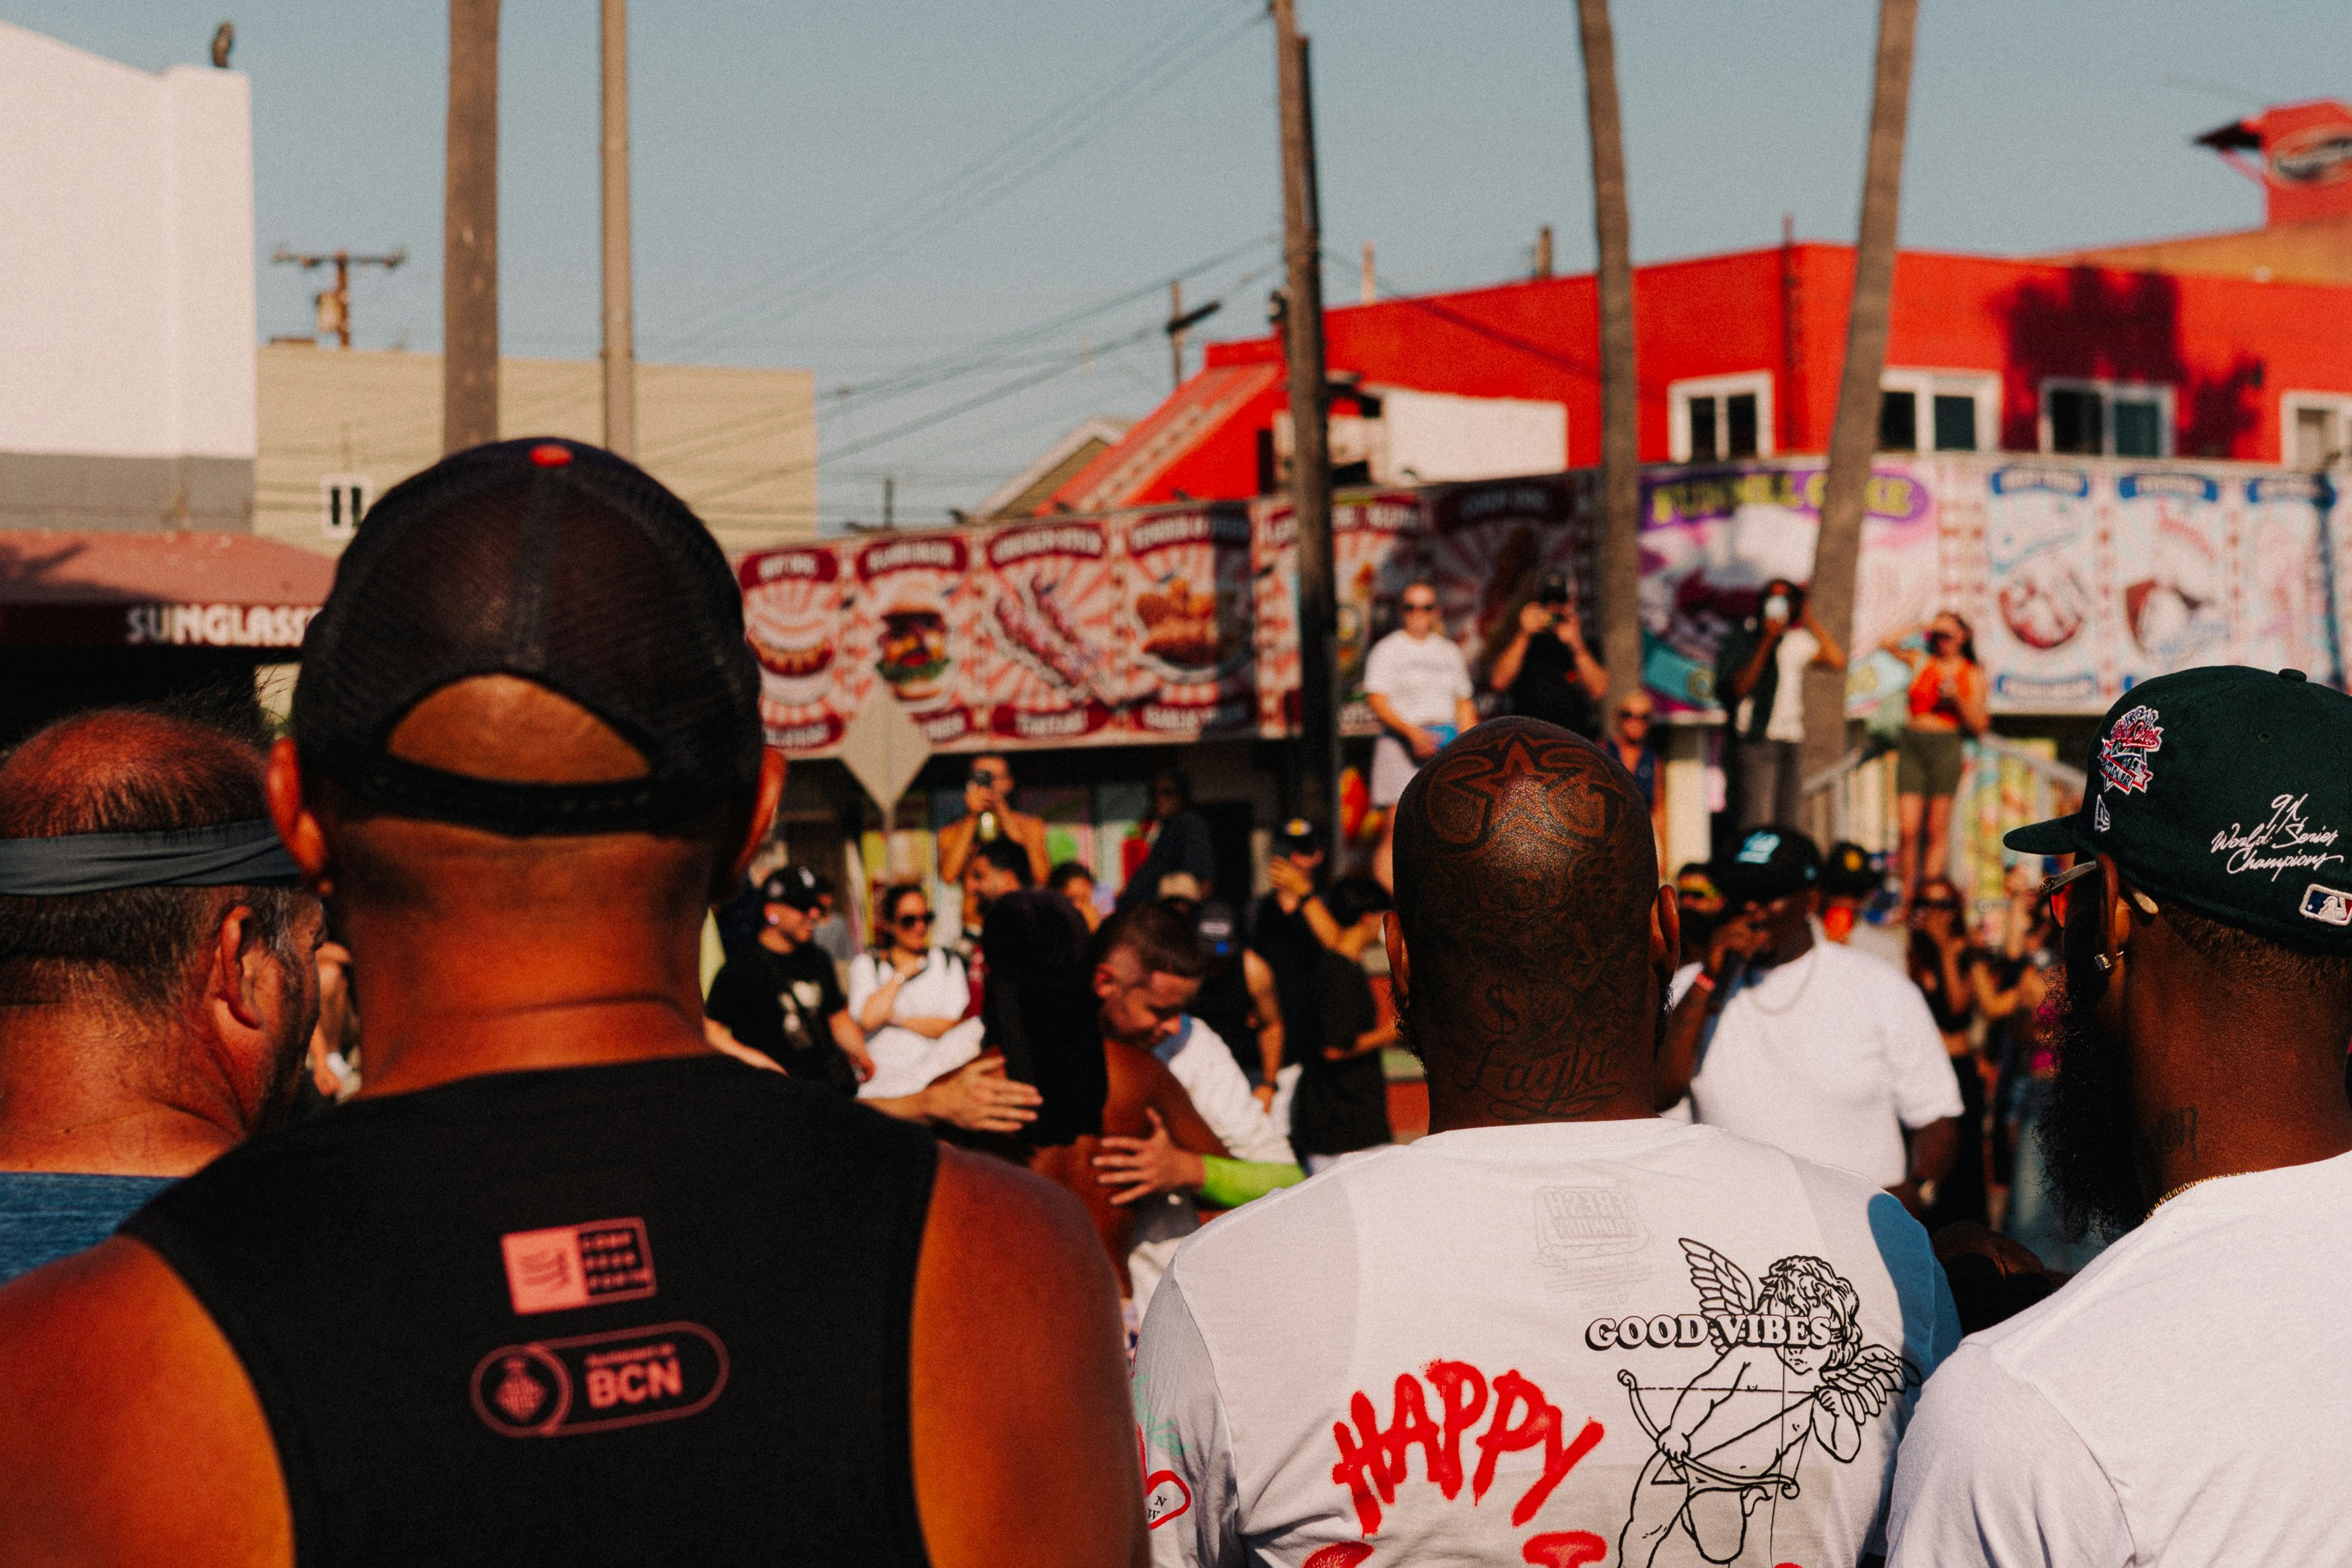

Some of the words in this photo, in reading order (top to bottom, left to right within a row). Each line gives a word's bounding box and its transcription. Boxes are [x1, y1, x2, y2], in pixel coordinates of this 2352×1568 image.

[126, 603, 324, 648] SUNGLASS
[2211, 822, 2273, 853] World
[2271, 817, 2339, 849] Series
[2226, 848, 2344, 882] Champions
[1585, 1314, 1708, 1351] GOOD
[1713, 1314, 1832, 1350] VIBES
[587, 1358, 682, 1408] BCN
[1333, 1359, 1605, 1538] HAPPY
